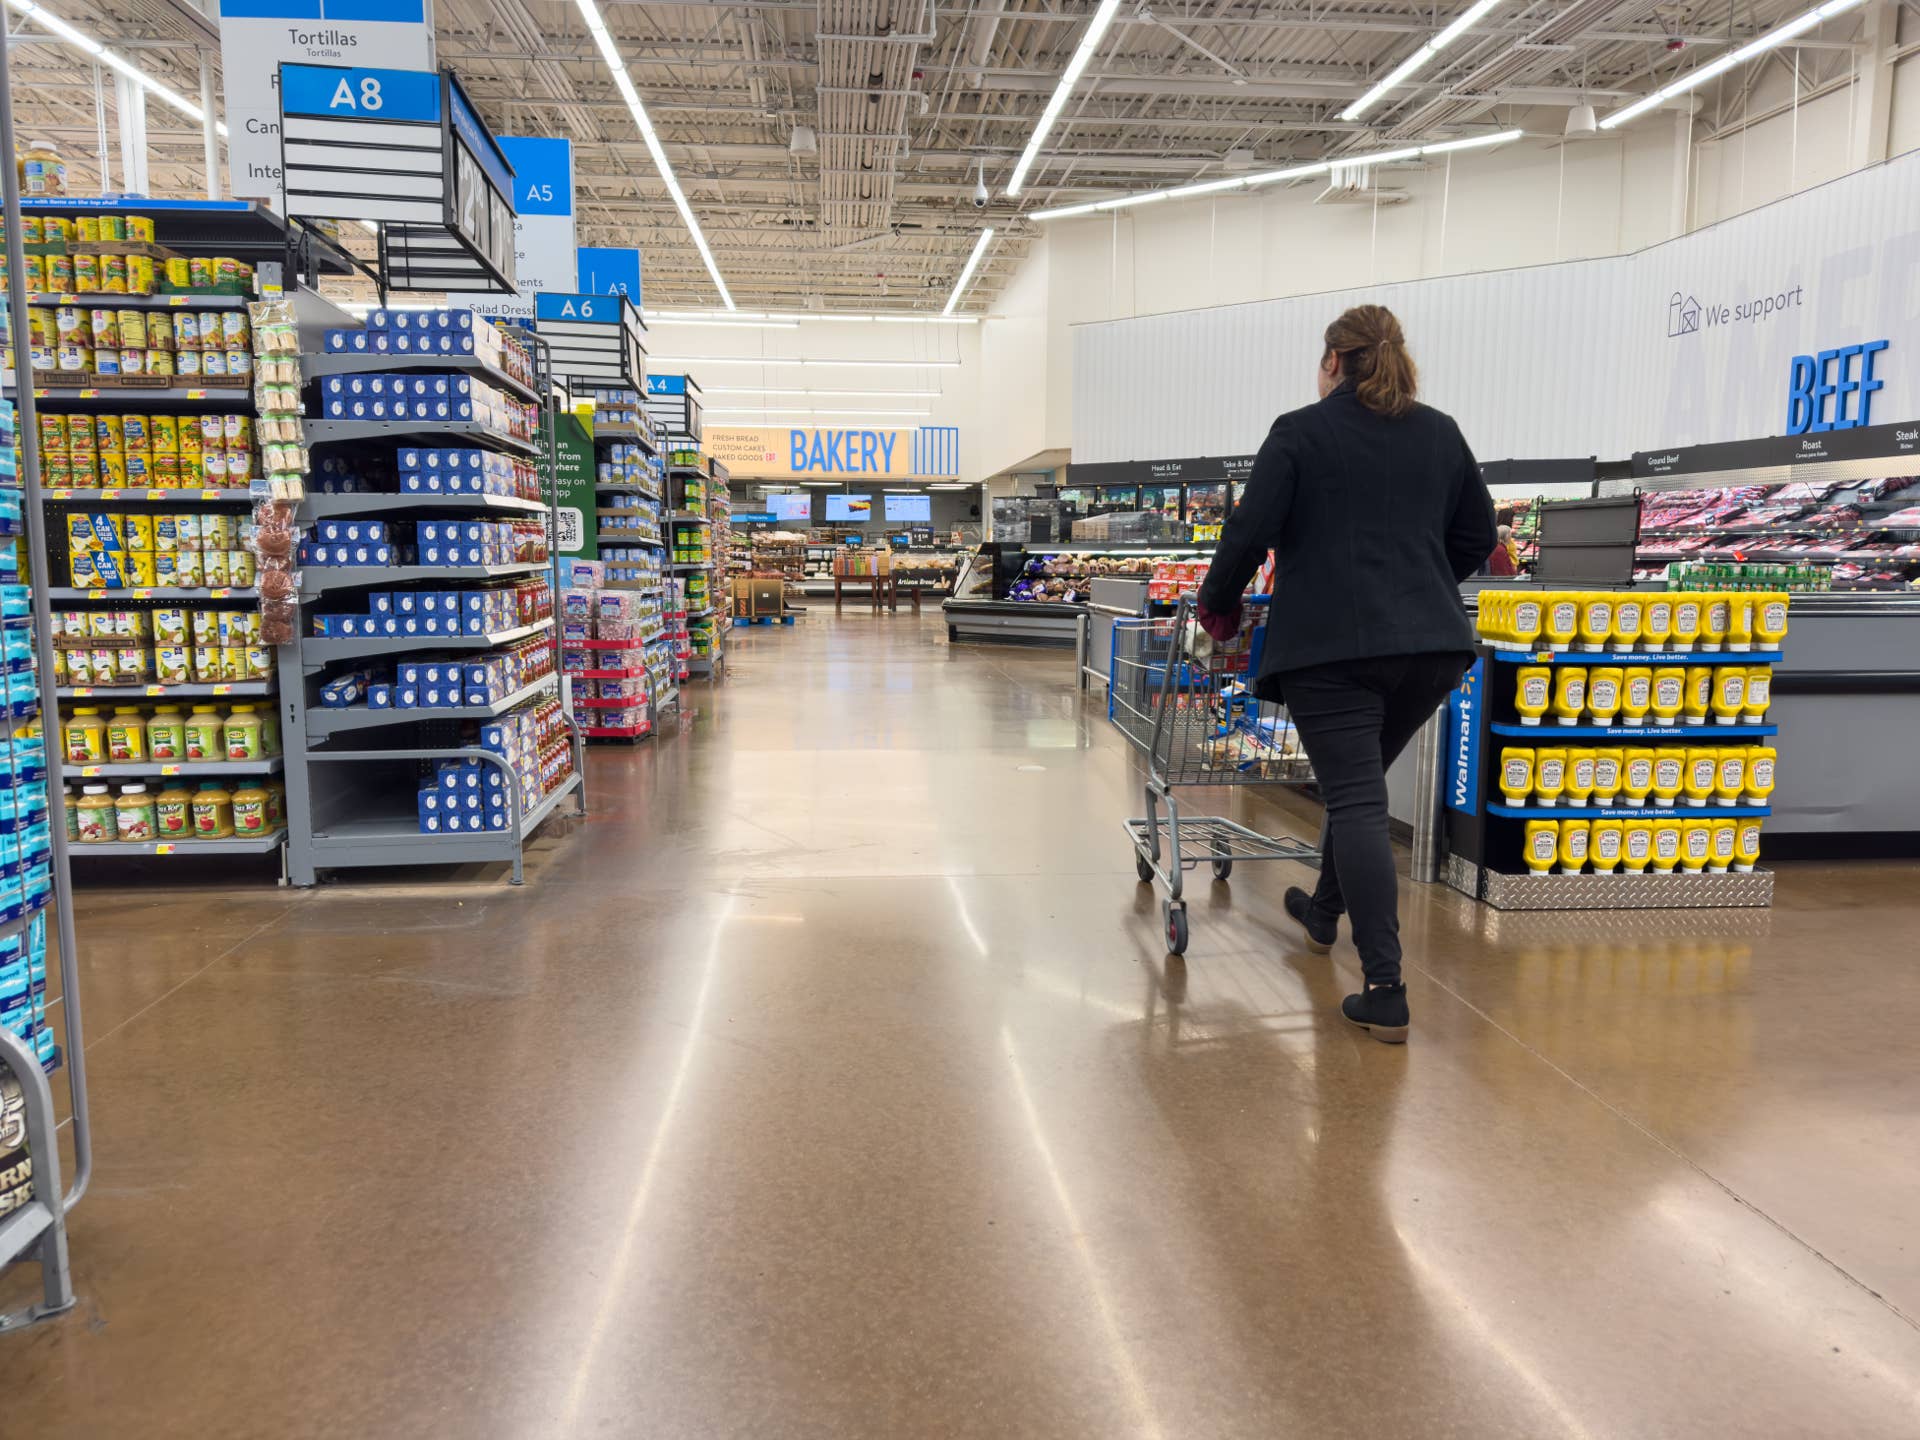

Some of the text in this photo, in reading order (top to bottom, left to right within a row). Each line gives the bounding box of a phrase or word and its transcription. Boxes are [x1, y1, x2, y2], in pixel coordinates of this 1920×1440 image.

[289, 28, 357, 46] Tortillas
[306, 48, 341, 57] Tortillas
[329, 77, 383, 111] A8
[526, 184, 553, 202] A5
[608, 283, 627, 295] A3
[469, 303, 498, 315] Salad
[1706, 285, 1803, 328] We support
[1786, 339, 1890, 437] BEEF
[1896, 429, 1918, 441] Steak
[534, 440, 568, 449] Fin an
[1802, 440, 1822, 450] Roast
[558, 451, 581, 461] from
[790, 429, 896, 473] BAKERY
[712, 453, 763, 462] BAKED GOODS
[1648, 454, 1679, 465] Ground Beef
[574, 478, 586, 486] on
[97, 552, 105, 562] 4
[1455, 699, 1471, 806] Walmart
